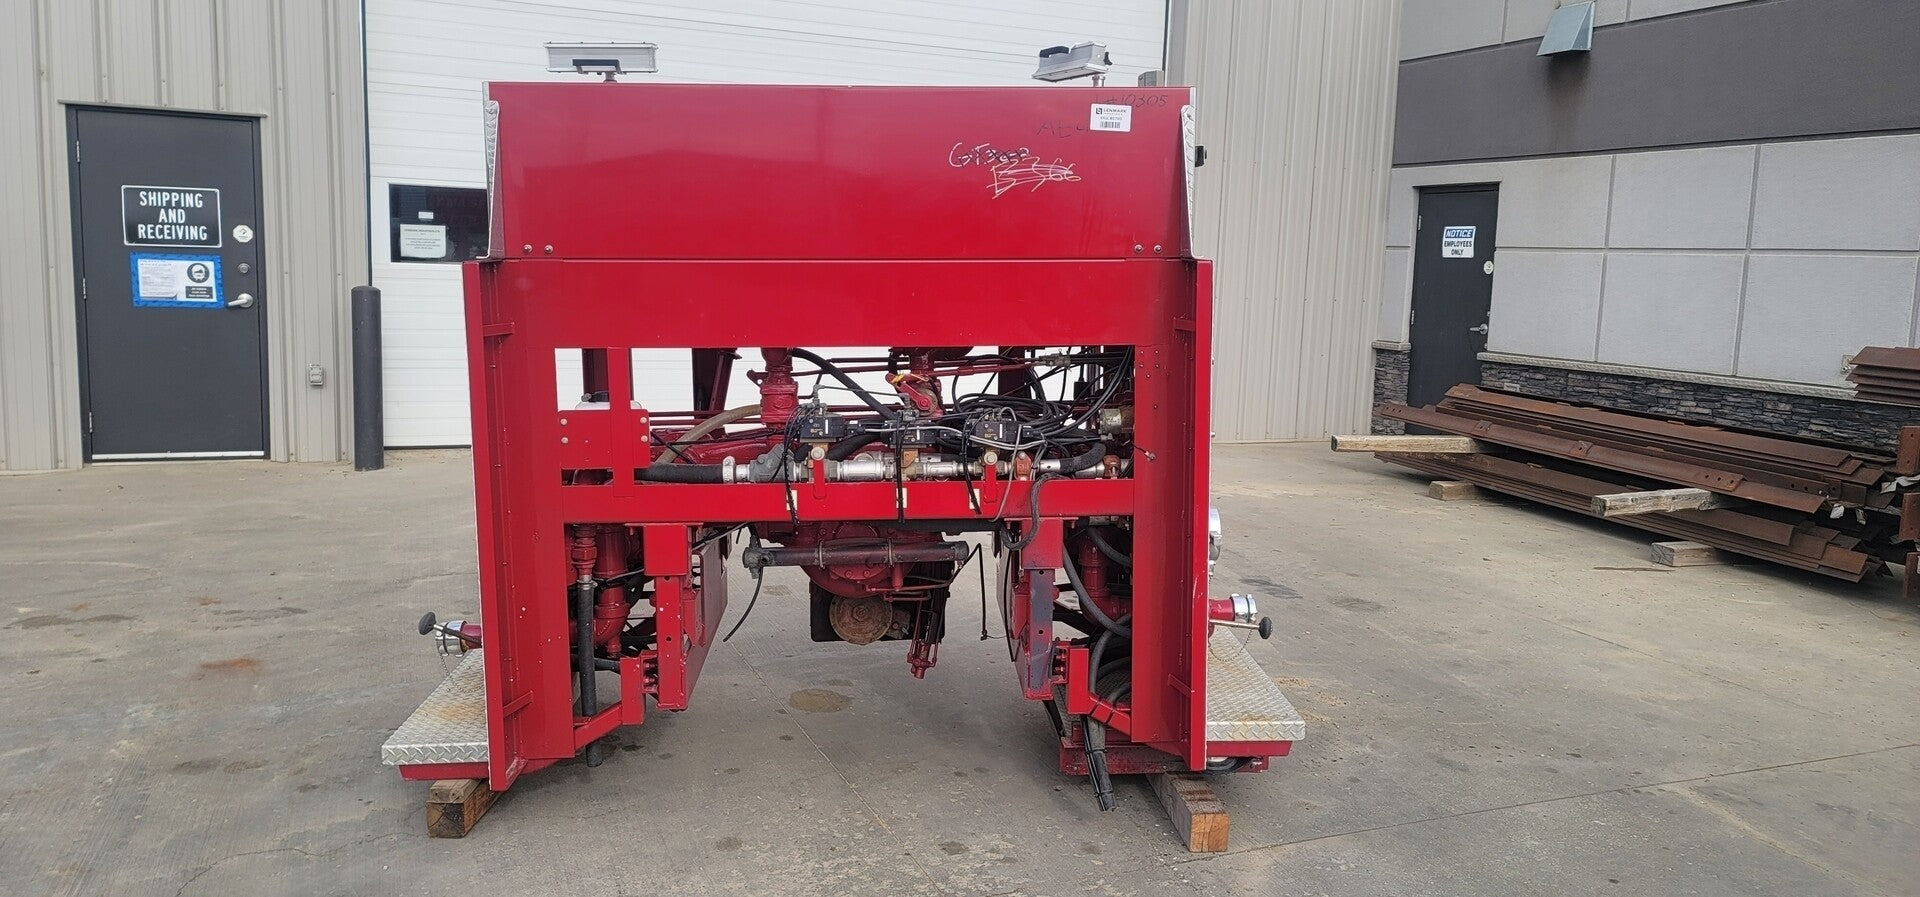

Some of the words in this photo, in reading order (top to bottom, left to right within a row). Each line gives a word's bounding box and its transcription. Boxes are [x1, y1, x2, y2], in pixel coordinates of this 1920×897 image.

[139, 191, 203, 208] SHIPPING
[158, 208, 186, 223] AND
[137, 224, 208, 240] RECEIVING
[1445, 229, 1472, 238] NOTICE
